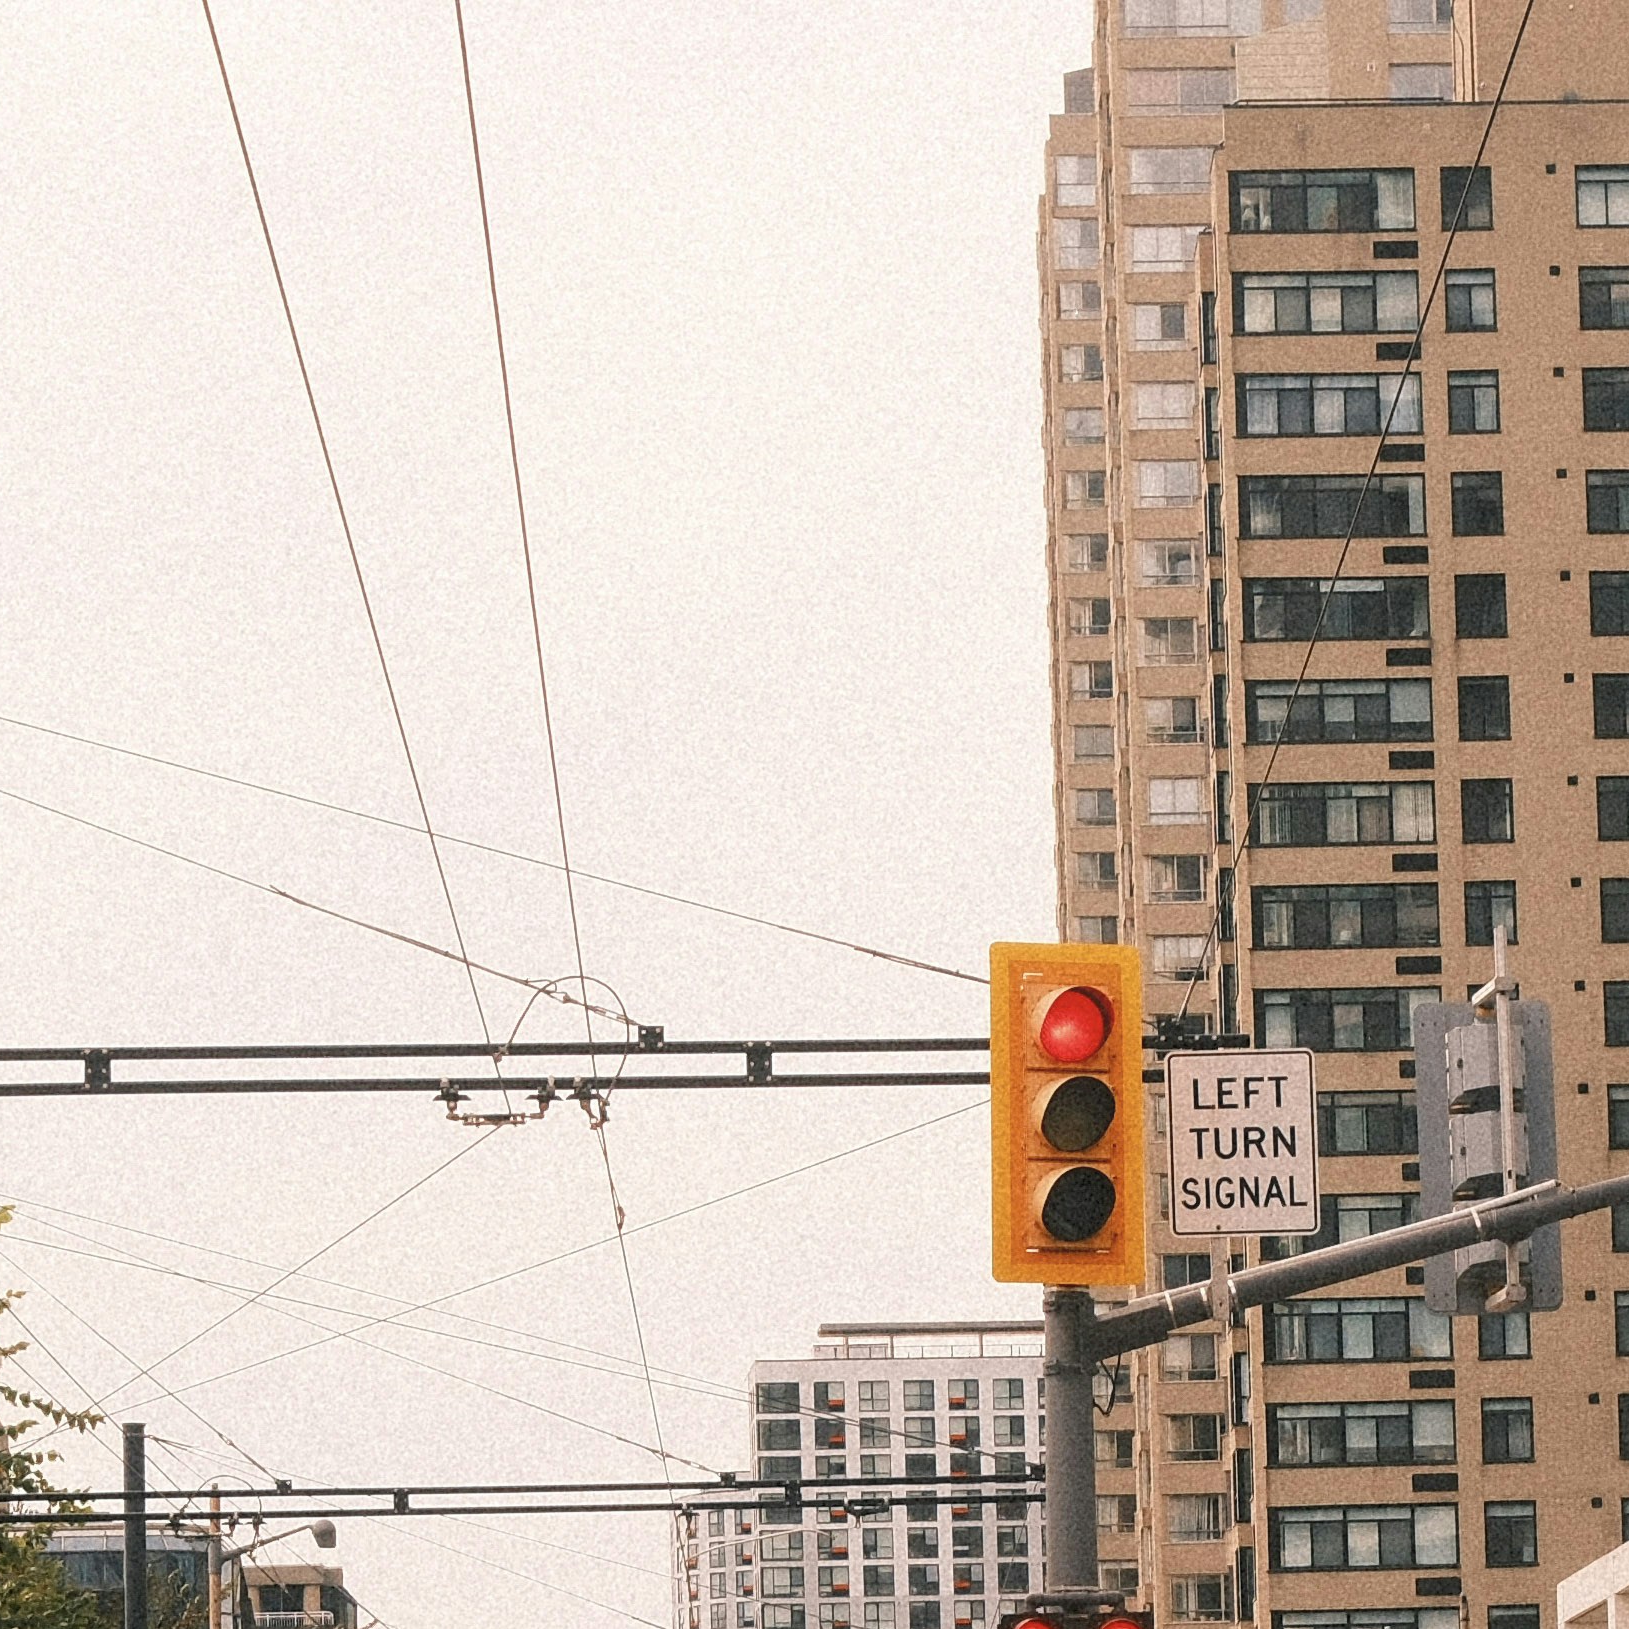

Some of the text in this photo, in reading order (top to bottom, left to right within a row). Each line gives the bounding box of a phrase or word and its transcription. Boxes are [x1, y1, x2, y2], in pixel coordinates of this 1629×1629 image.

[1193, 1076, 1288, 1110] LEFT
[1189, 1126, 1297, 1160] TURN
[1181, 1176, 1308, 1210] SIGNAL
